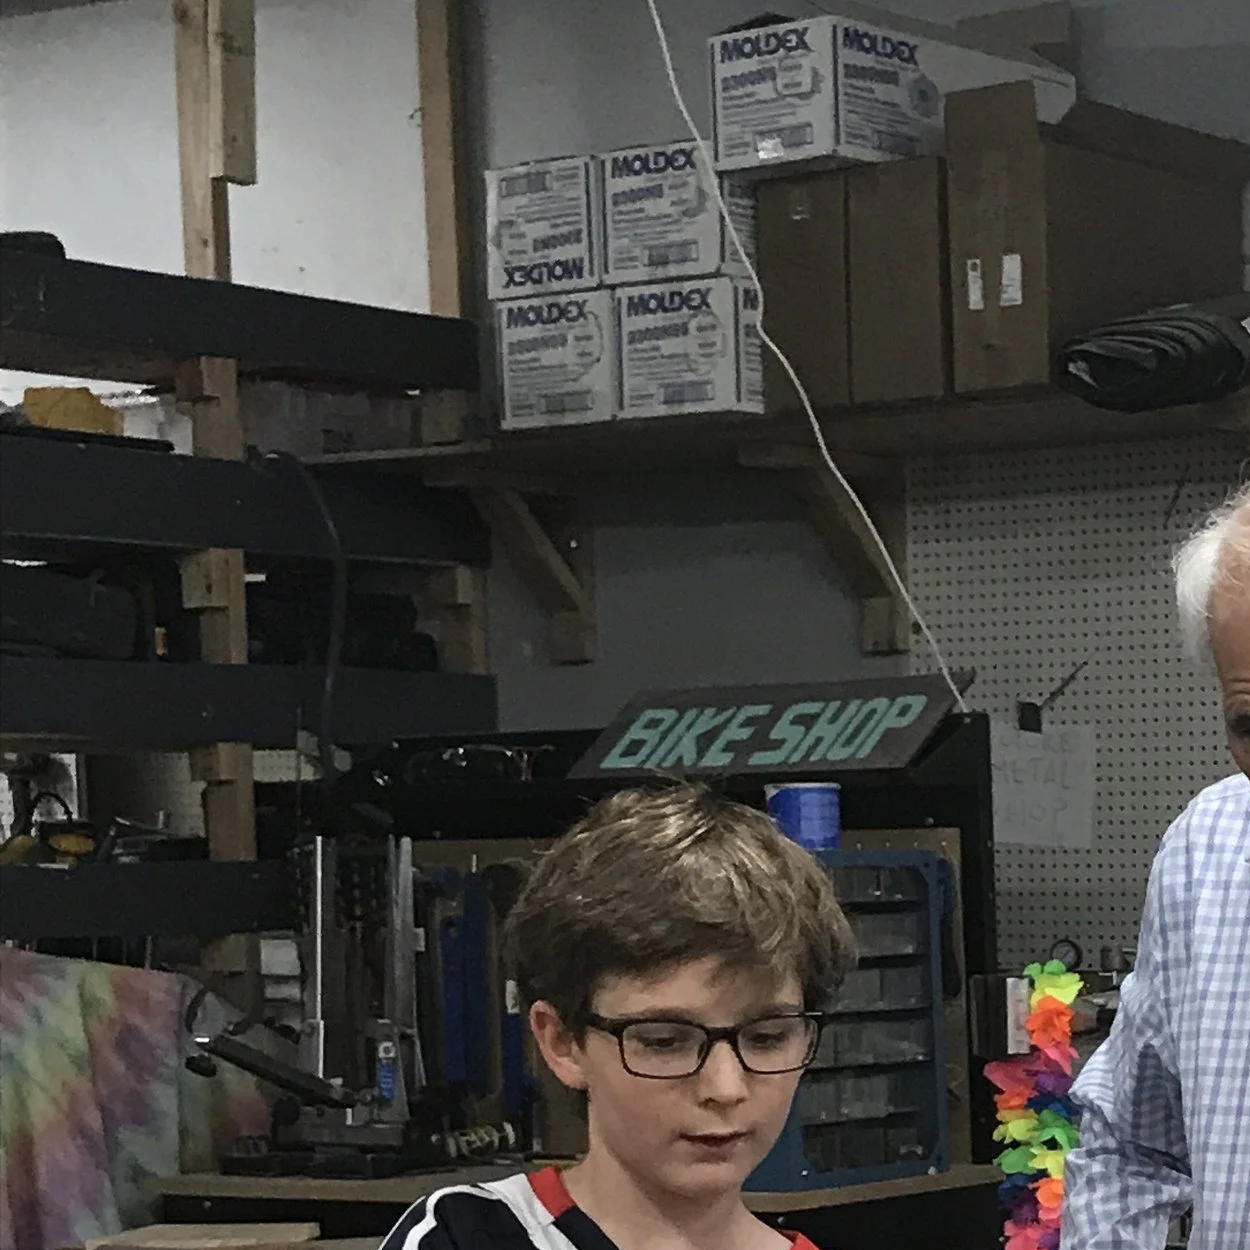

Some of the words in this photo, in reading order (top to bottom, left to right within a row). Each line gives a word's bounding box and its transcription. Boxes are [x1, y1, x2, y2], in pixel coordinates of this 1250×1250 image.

[720, 27, 811, 63] MOLDEX
[843, 27, 919, 65] MOLDEX
[611, 149, 696, 179] MOLDEX
[503, 257, 584, 289] MOLDEX
[507, 300, 589, 329] MOLDEX
[627, 287, 713, 318] MOLDEX
[600, 704, 772, 769] BIKE
[748, 695, 928, 766] SHOP
